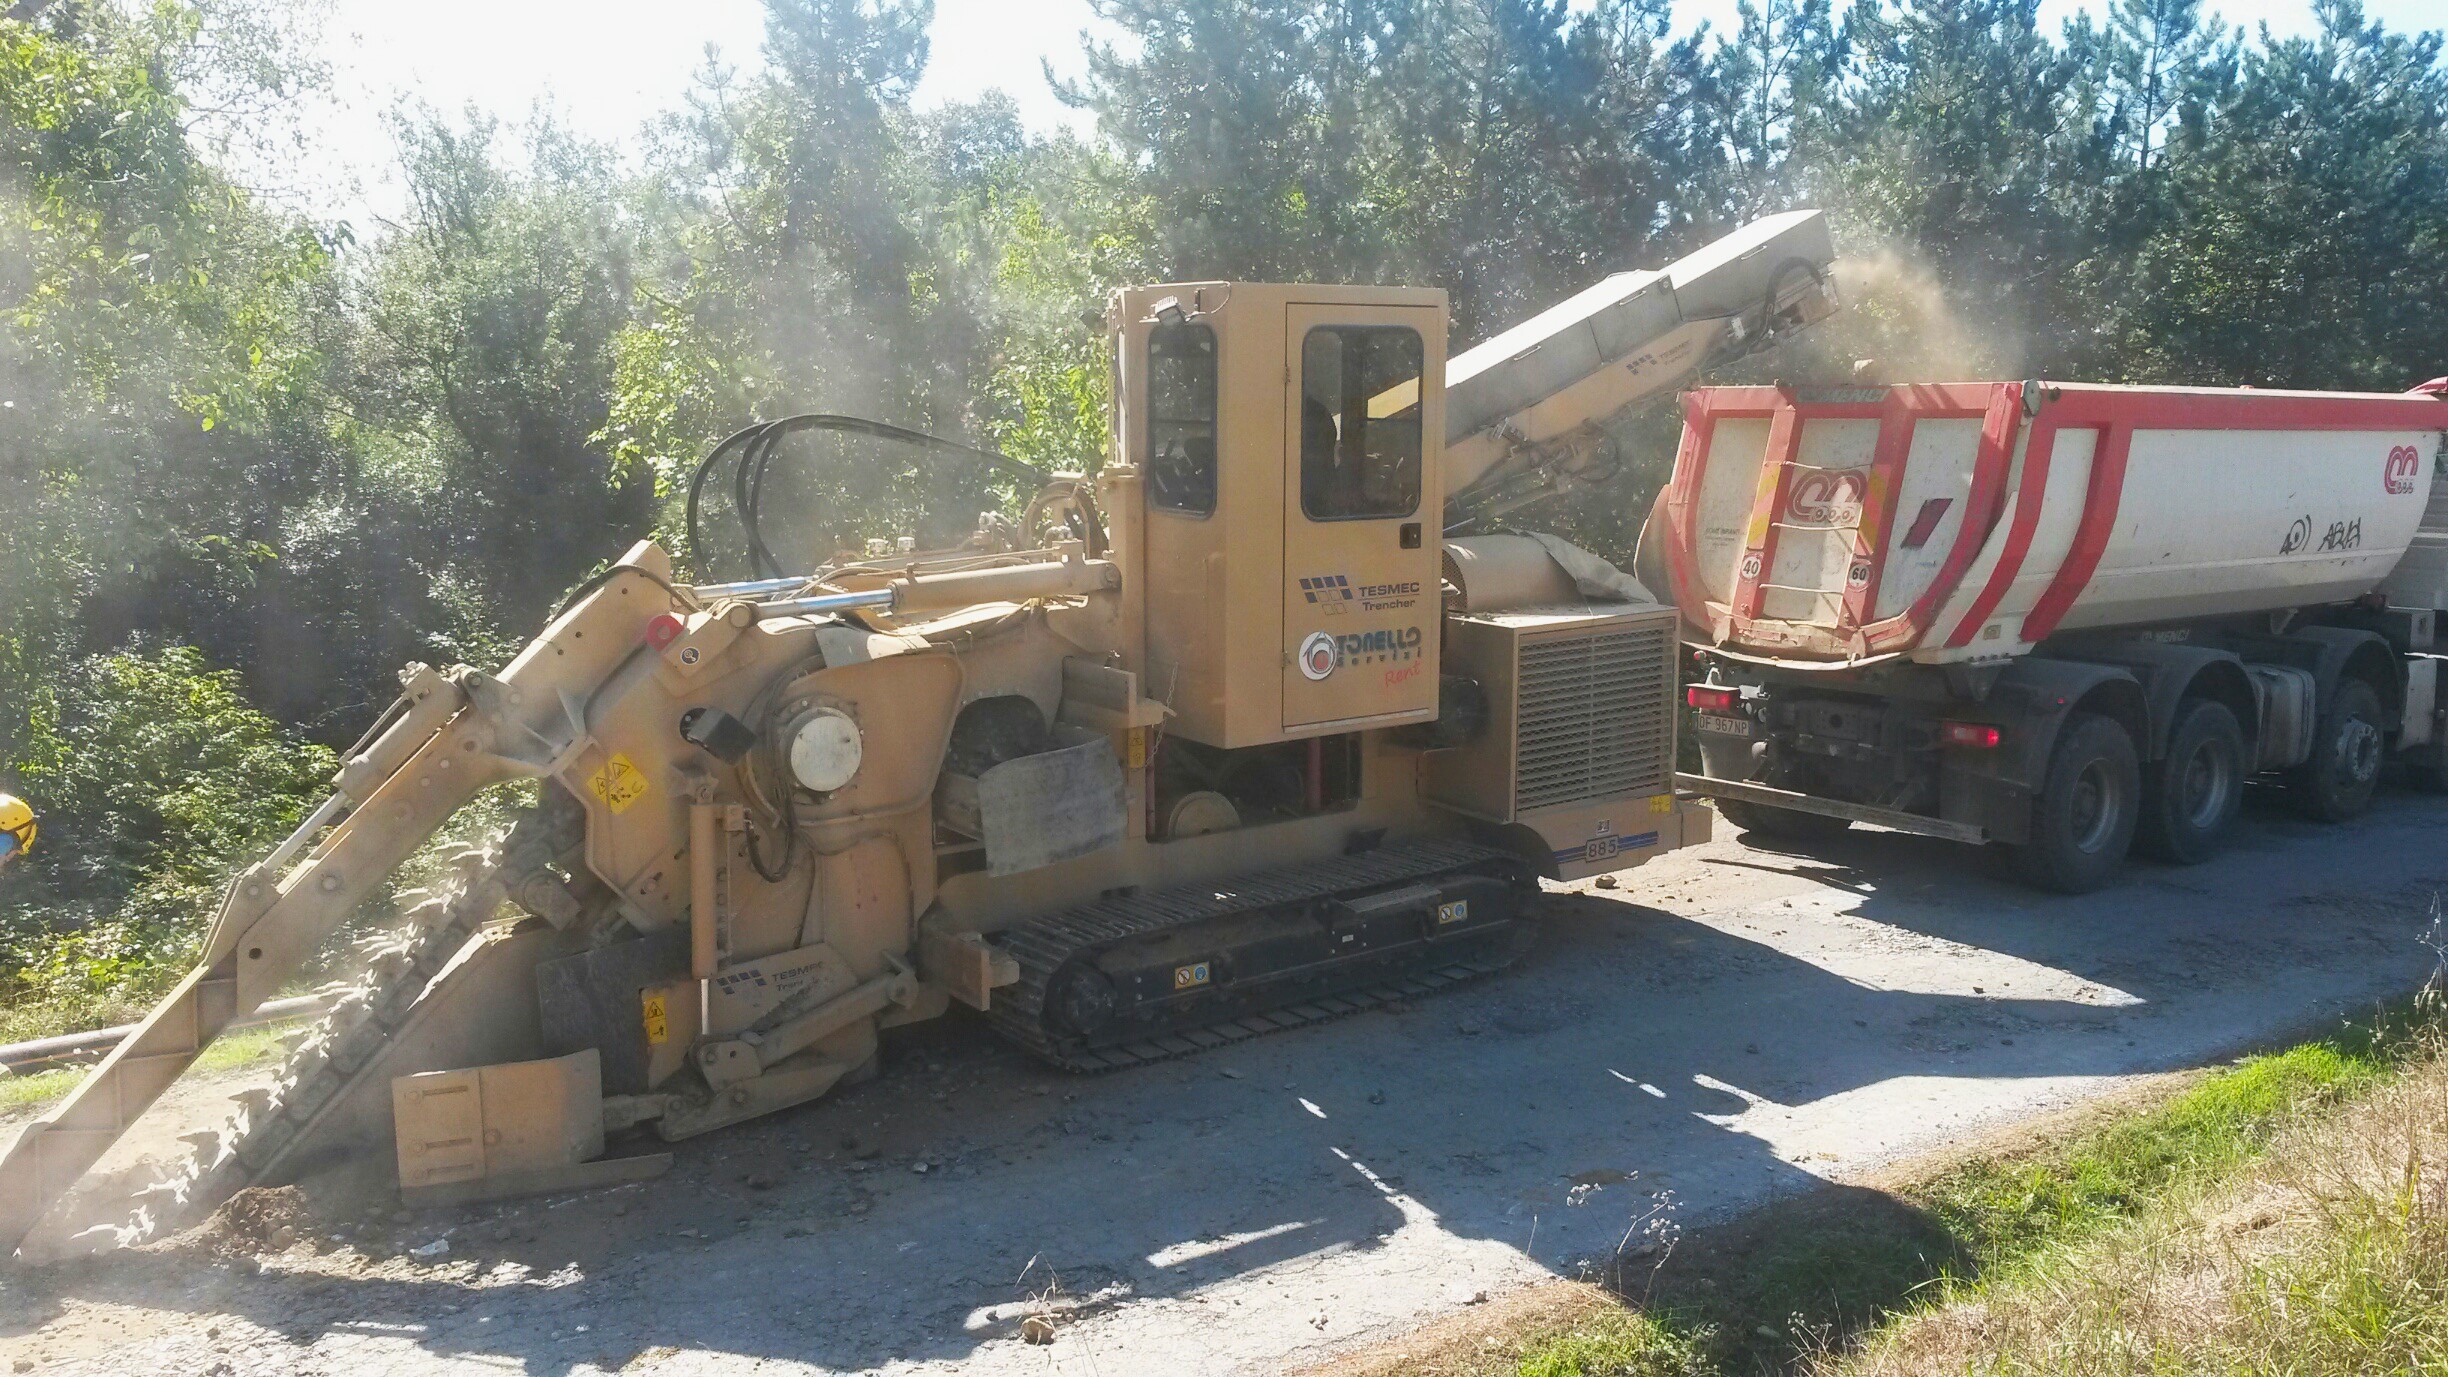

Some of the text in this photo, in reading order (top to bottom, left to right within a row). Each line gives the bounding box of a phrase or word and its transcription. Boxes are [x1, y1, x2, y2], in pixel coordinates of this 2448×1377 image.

[1743, 560, 1759, 575] 40
[1852, 567, 1867, 581] 60
[1358, 582, 1420, 597] TESMEC
[1362, 600, 1415, 611] Trencher
[1384, 660, 1422, 687] Rent
[1715, 718, 1747, 734] 967NP
[1589, 840, 1616, 858] 885
